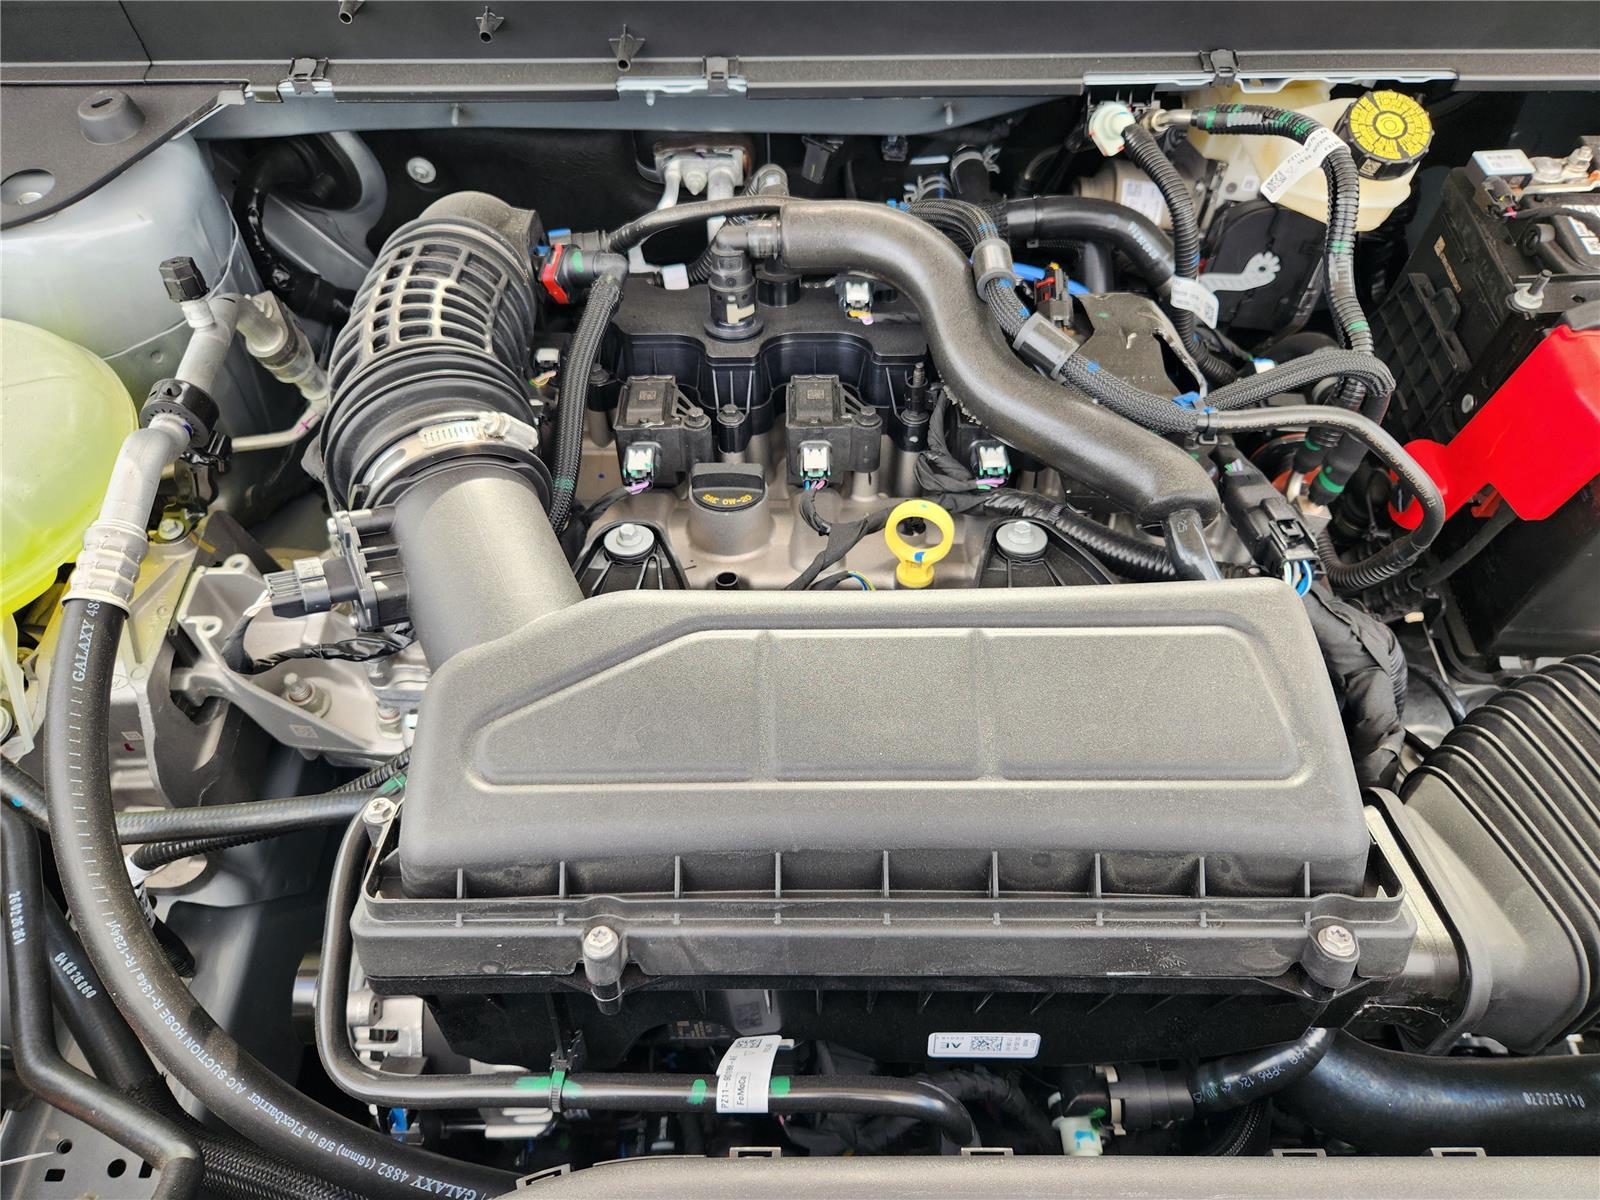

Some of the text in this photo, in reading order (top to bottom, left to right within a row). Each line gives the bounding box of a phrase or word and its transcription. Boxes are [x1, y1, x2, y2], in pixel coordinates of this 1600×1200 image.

[703, 493, 752, 505] SAE 0W-20
[73, 599, 100, 681] GALAXY 48
[105, 920, 137, 967] R-1234yf
[134, 972, 164, 1010] R-134a
[159, 1007, 187, 1039] HOSE
[184, 1037, 228, 1081] SUCTION
[224, 1075, 246, 1095] A/C
[247, 1092, 307, 1137] Flexbarrier
[317, 1136, 336, 1152] 5/8
[336, 1143, 376, 1170] (16mm)
[378, 1162, 410, 1183] 4882
[409, 1174, 477, 1200] GALAXY
